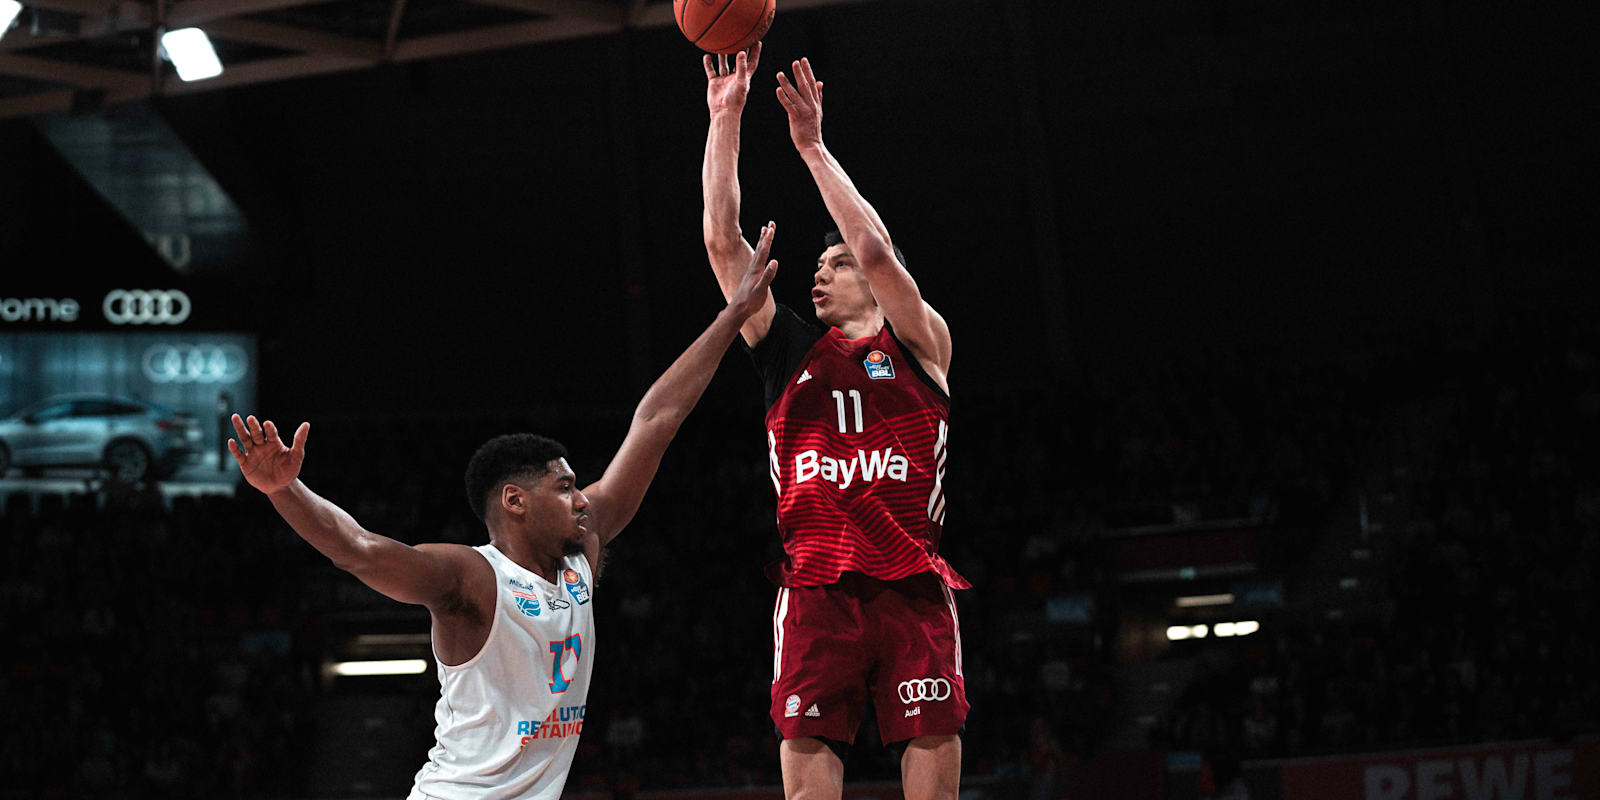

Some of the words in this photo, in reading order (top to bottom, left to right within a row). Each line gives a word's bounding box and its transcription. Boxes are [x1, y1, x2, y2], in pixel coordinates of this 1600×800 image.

[0, 297, 80, 322] ome
[872, 369, 892, 378] BBL
[831, 389, 864, 433] 11
[795, 447, 908, 489] BayWa
[904, 706, 921, 719] Audi
[1364, 750, 1576, 800] REWE
